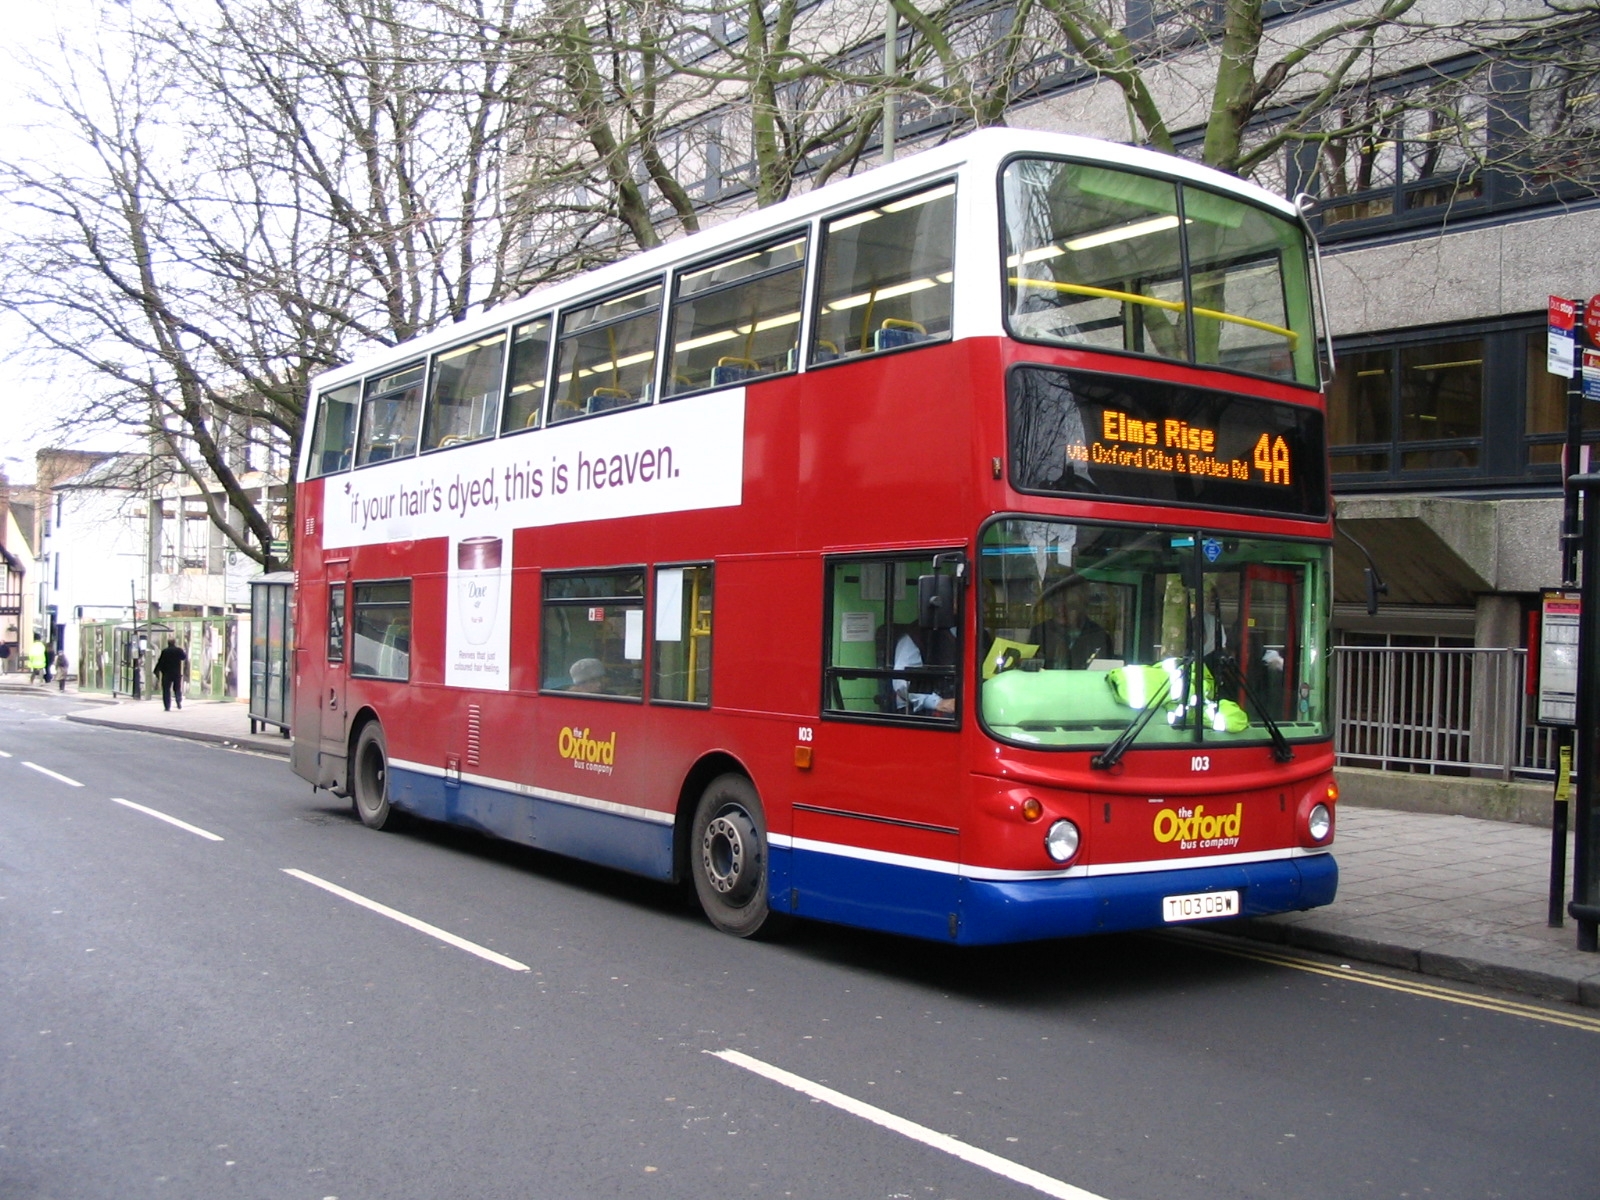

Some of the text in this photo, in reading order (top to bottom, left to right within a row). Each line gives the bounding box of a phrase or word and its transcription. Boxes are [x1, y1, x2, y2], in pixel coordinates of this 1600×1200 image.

[1560, 302, 1574, 318] stop
[1103, 410, 1215, 453] Elms Rise
[1066, 440, 1249, 481] via Oxford City & Botley Rd
[1253, 432, 1290, 485] 4A
[350, 445, 680, 531] if your hair's dyed, this is heaven.
[468, 581, 488, 598] Dove
[573, 727, 583, 738] the
[798, 726, 813, 742] 103
[559, 726, 616, 766] Oxford
[574, 759, 613, 776] bus company
[1191, 756, 1210, 771] 103
[1178, 807, 1193, 818] the
[1153, 803, 1243, 843] Oxford
[1180, 837, 1239, 850] bus company
[1169, 895, 1232, 917] T103 DBW
